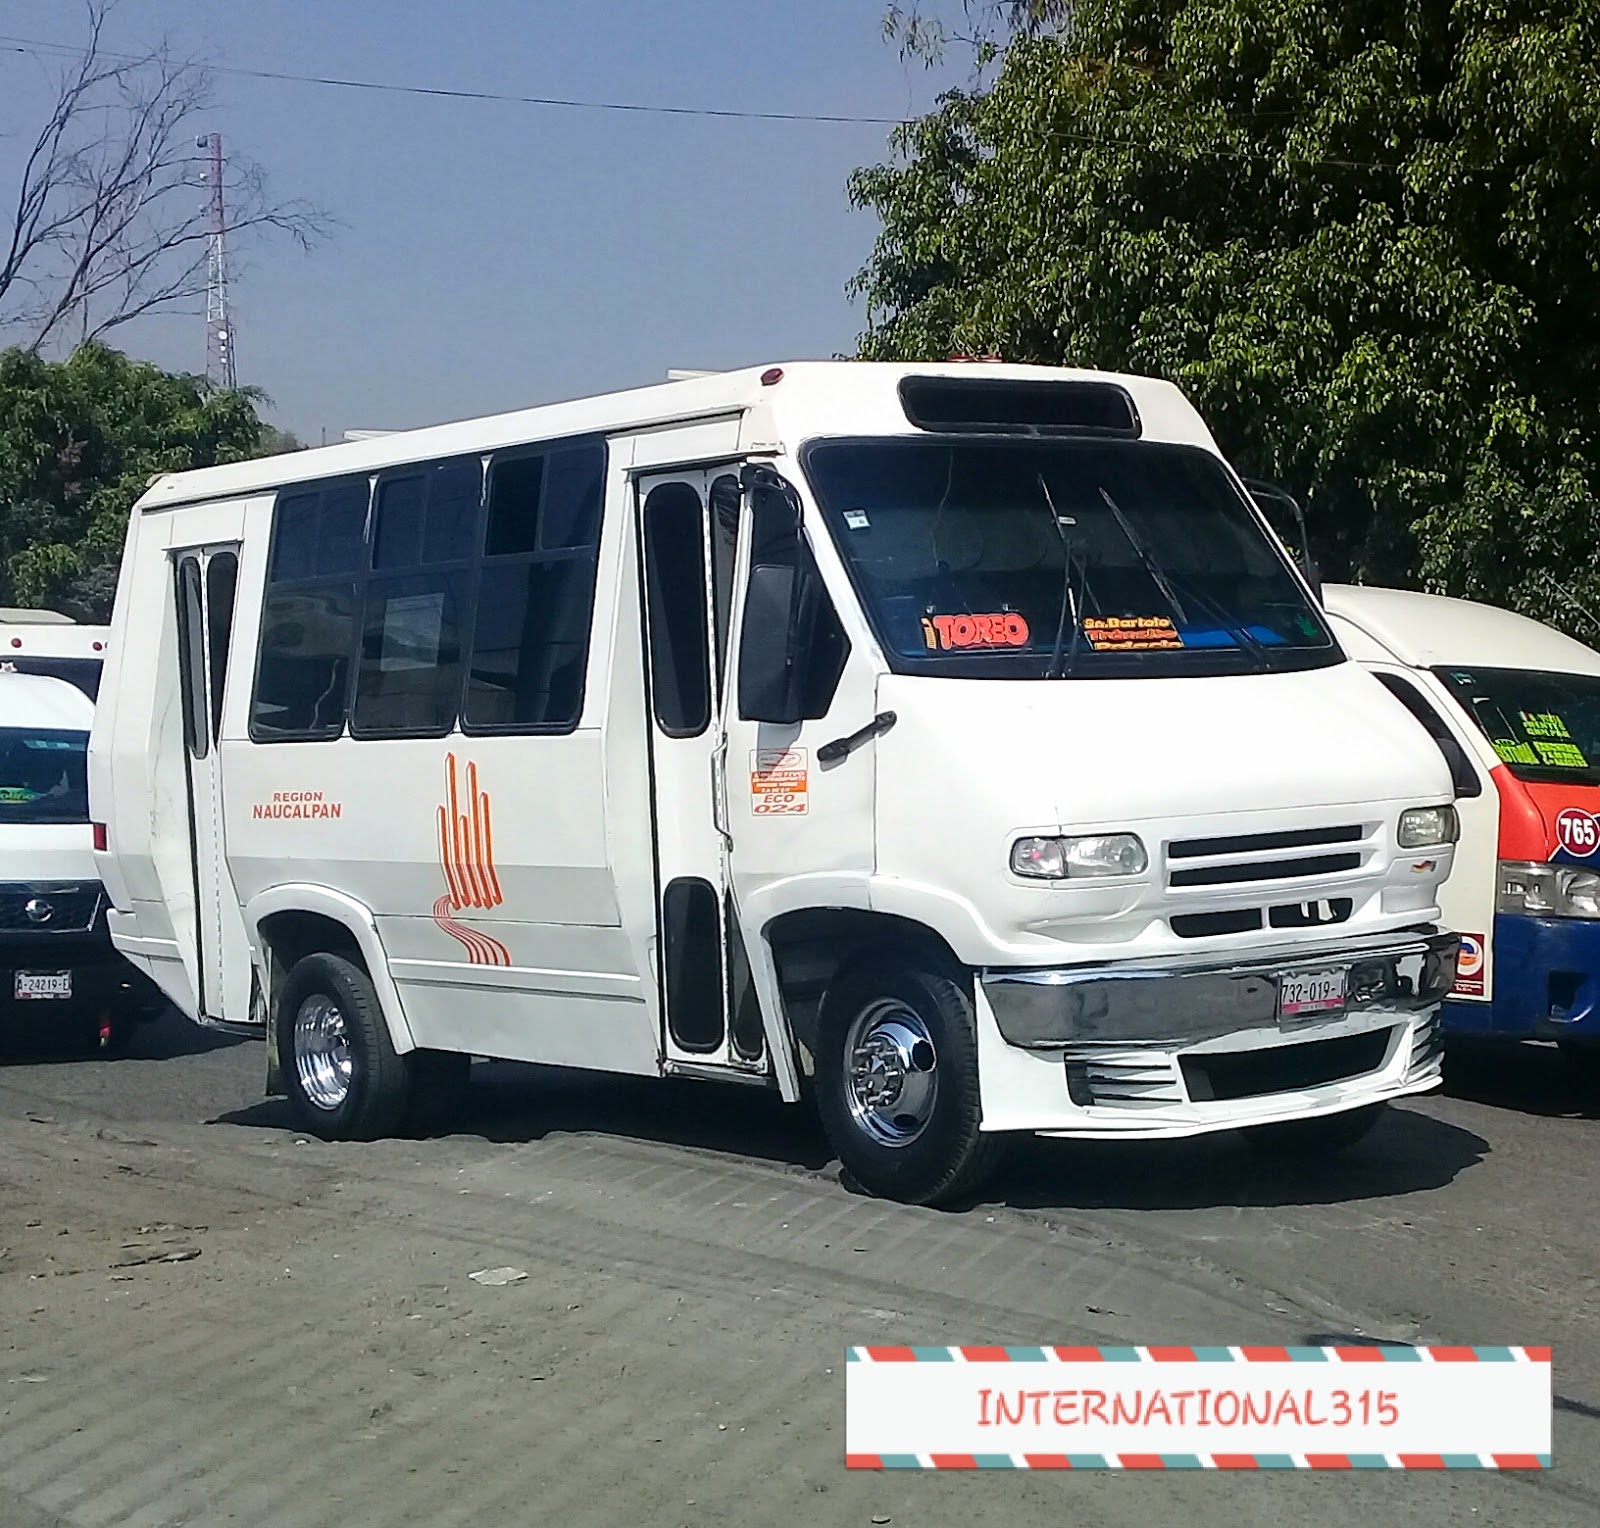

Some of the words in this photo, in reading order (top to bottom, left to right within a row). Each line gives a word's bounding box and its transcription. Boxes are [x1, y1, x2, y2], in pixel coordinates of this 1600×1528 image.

[933, 613, 1029, 650] TOREO
[754, 804, 806, 813] 024
[763, 794, 795, 803] ECO
[253, 803, 341, 819] NAUCALPAN
[1560, 817, 1595, 846] 765
[1282, 979, 1344, 1003] 732-019-J
